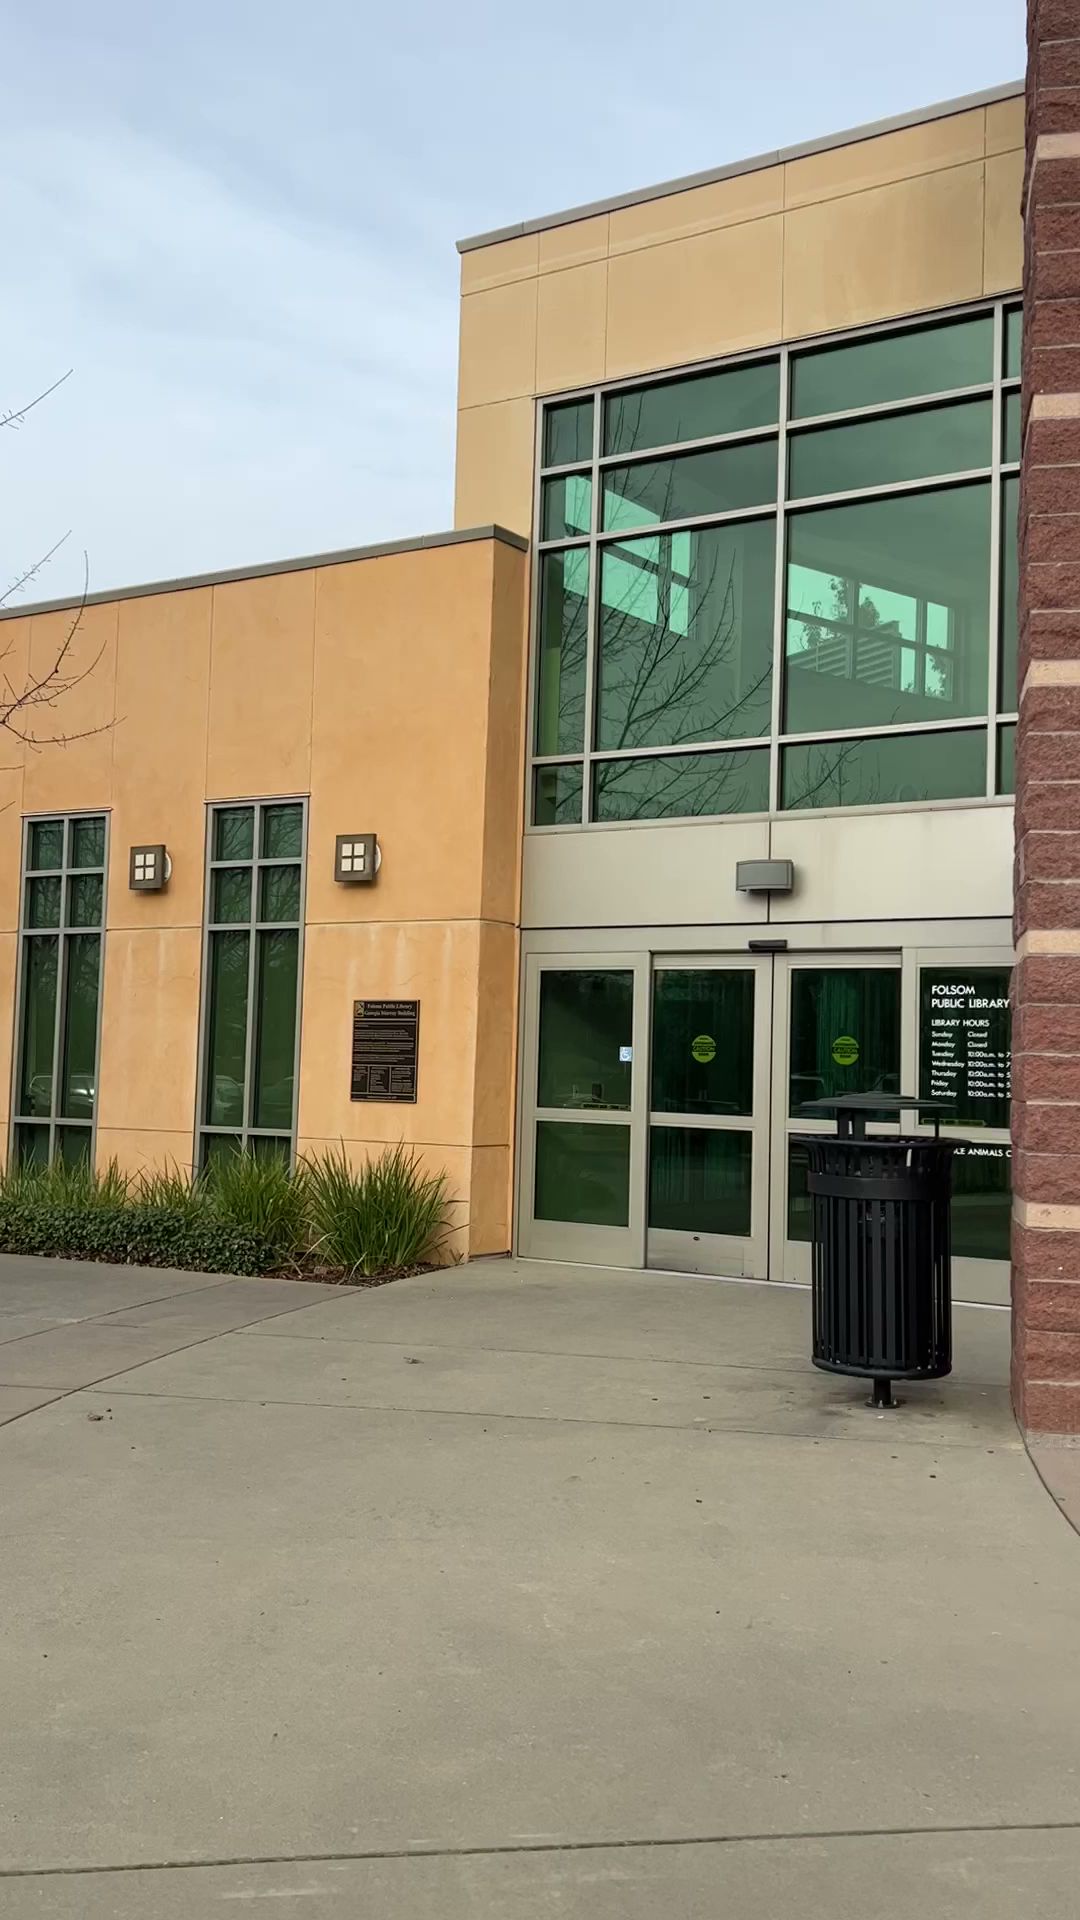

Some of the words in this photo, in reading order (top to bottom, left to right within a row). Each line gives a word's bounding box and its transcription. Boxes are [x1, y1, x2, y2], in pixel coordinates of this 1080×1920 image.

[931, 984, 976, 995] FOLSOM
[931, 998, 964, 1008] PUBLIC
[968, 998, 1010, 1008] LIBRARY
[931, 1050, 954, 1058] Tuesday
[931, 1070, 957, 1078] Thursday
[967, 1148, 1003, 1157] ANIMALS
